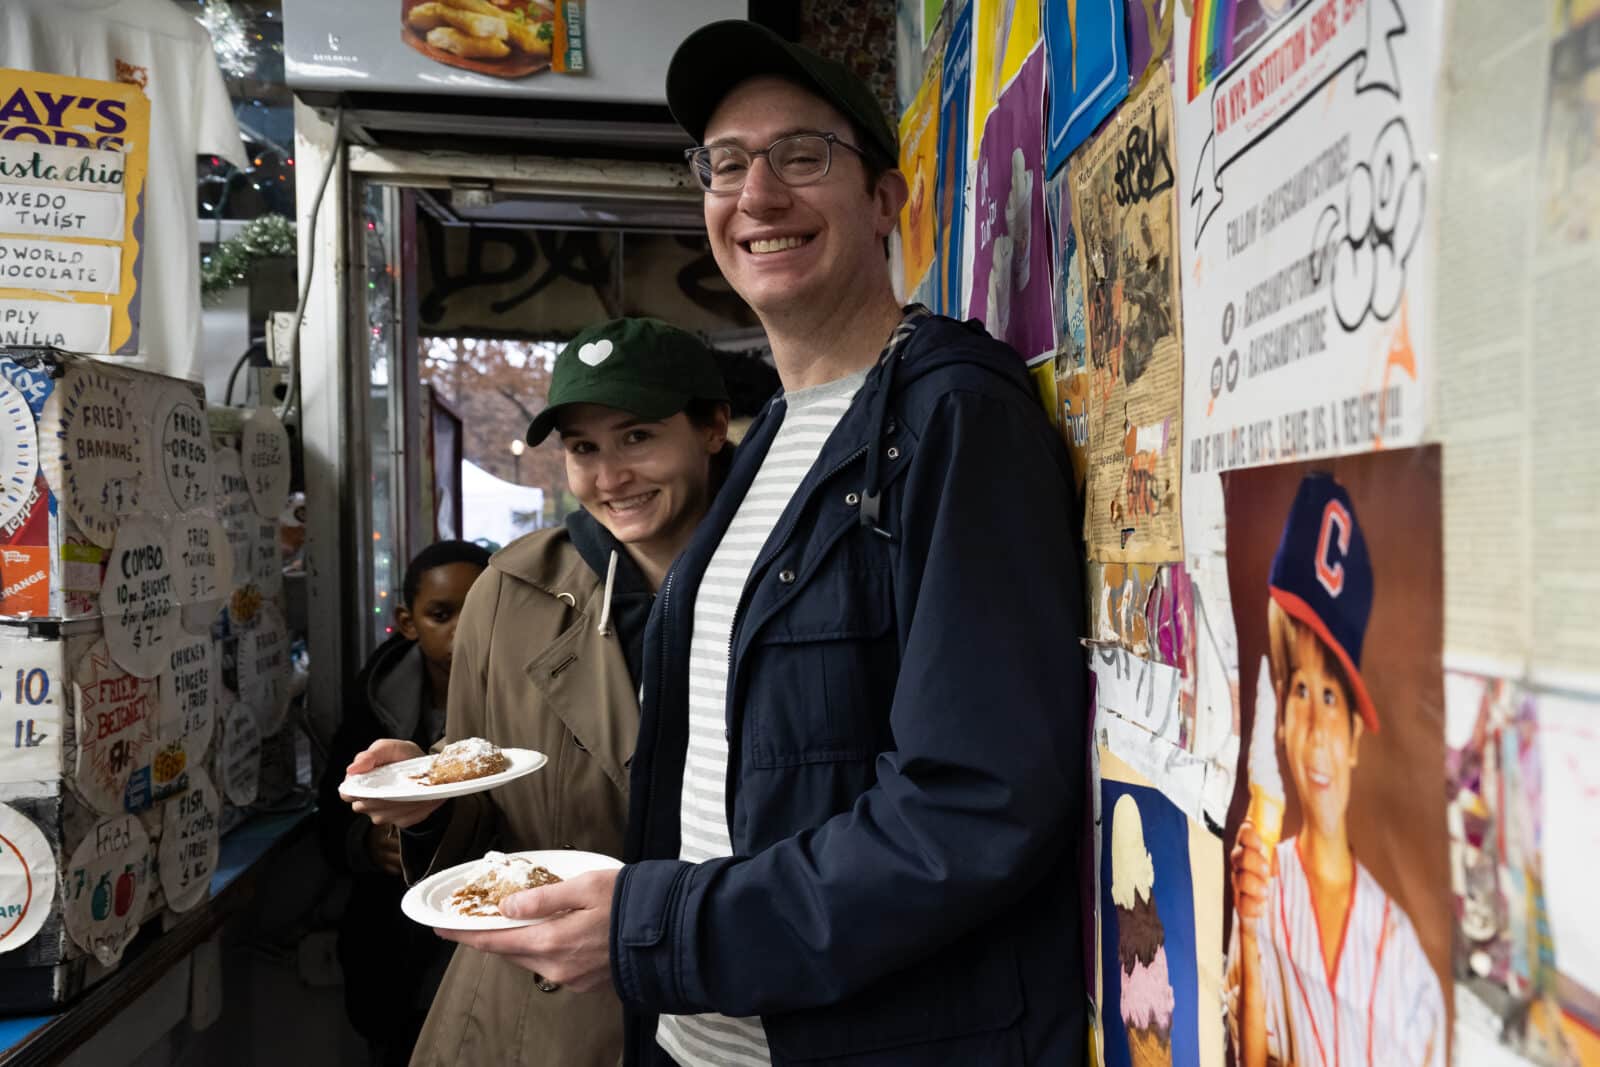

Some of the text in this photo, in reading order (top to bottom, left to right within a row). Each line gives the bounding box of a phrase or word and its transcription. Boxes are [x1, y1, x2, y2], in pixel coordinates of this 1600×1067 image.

[1229, 78, 1247, 126] NYC
[1249, 23, 1306, 110] INSTITUTION
[13, 246, 84, 264] WORLD
[0, 309, 39, 325] PLY
[82, 405, 125, 430] FRIED
[1279, 409, 1310, 457] LEAVE
[76, 438, 133, 462] BANANAS
[121, 544, 163, 580] COMBO
[1314, 499, 1352, 598] C
[97, 694, 148, 740] BEIGNET
